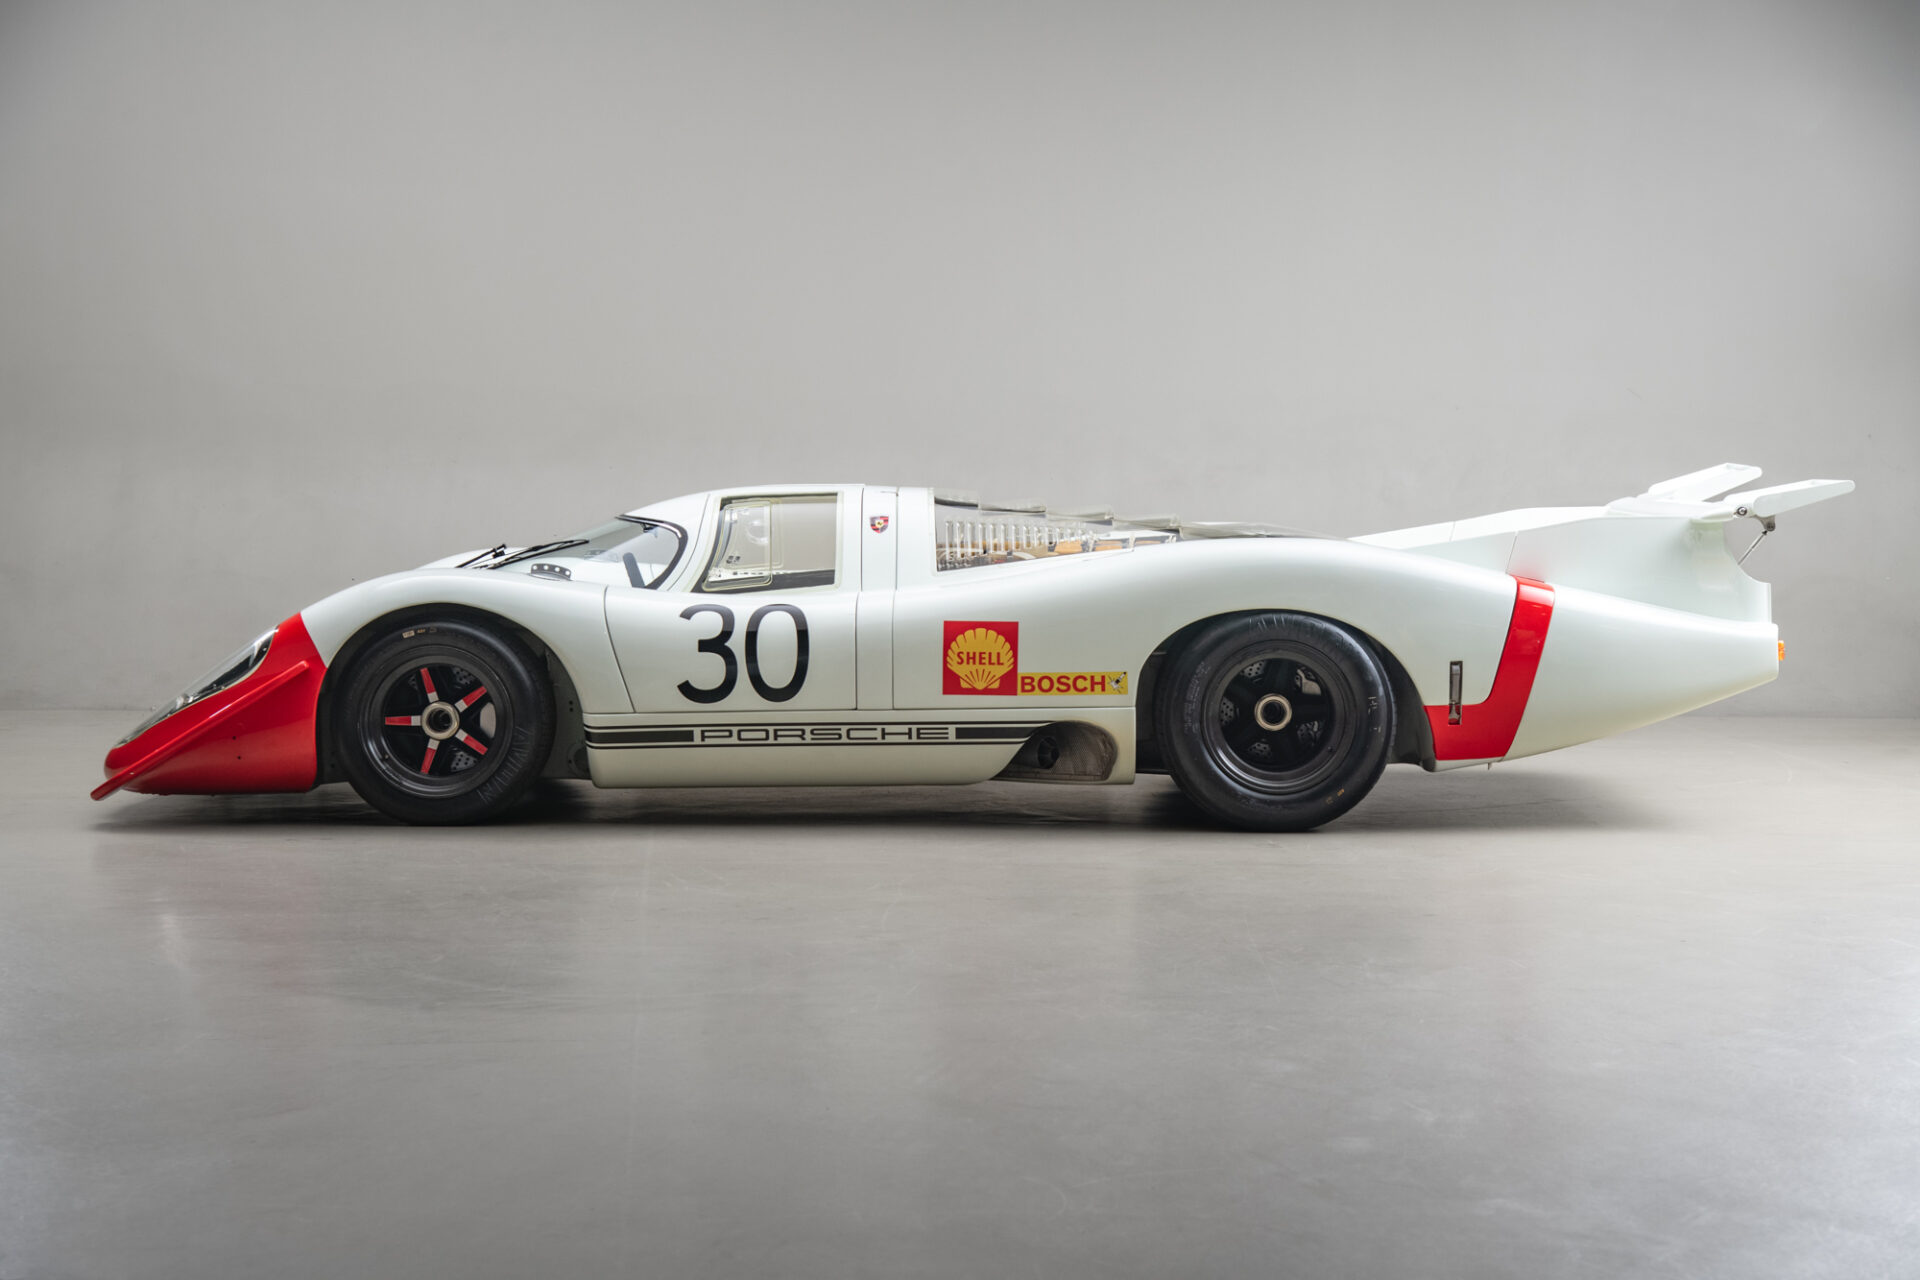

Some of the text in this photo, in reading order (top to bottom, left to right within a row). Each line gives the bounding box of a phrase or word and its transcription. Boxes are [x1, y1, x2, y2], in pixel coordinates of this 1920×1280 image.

[677, 603, 810, 704] 30
[956, 651, 1004, 666] SHELL
[1020, 675, 1106, 693] BOSCH
[700, 727, 949, 742] PORSCHE
